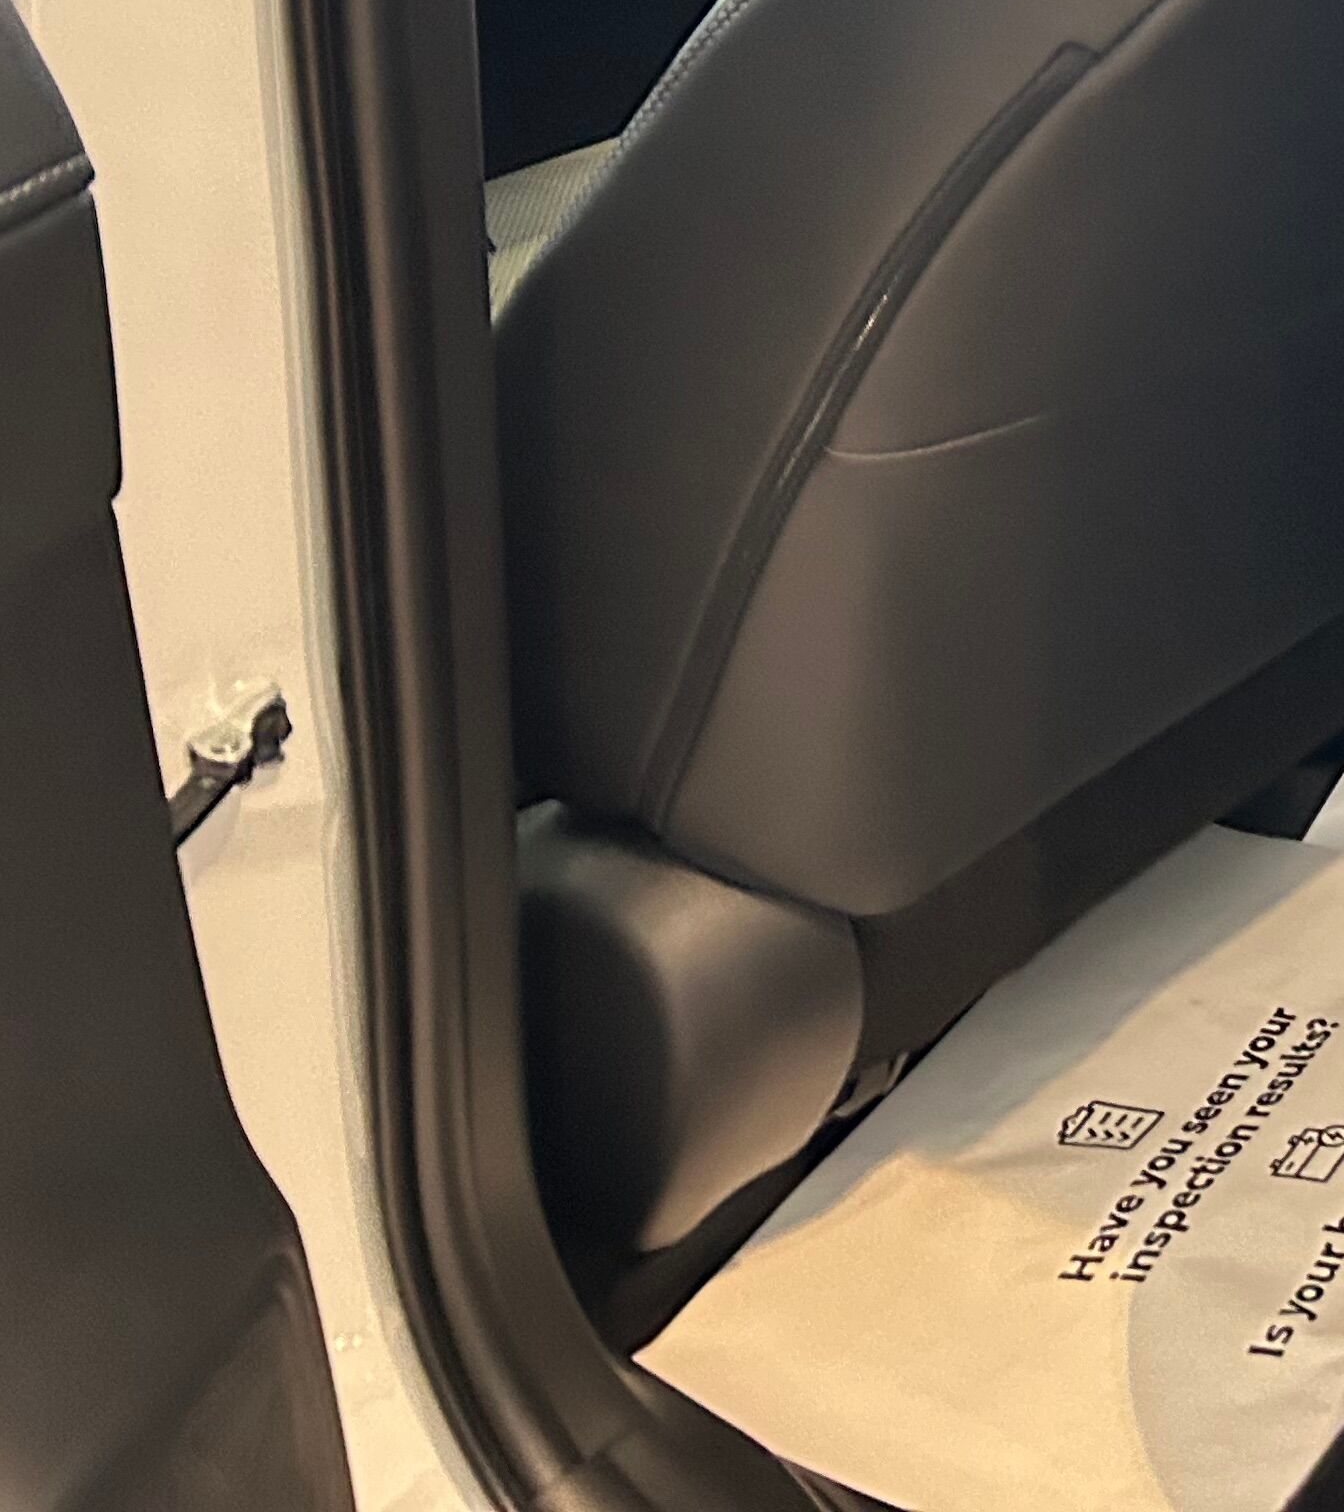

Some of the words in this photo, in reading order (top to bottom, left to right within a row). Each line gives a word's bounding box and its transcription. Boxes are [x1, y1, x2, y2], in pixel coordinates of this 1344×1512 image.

[1059, 1194, 1145, 1282] Have
[1131, 1138, 1194, 1190] you
[1183, 1073, 1250, 1134] seen
[1234, 1006, 1298, 1070] your
[1110, 1124, 1260, 1284] inspection
[1246, 1018, 1340, 1118] results?
[1248, 1325, 1294, 1358] Is
